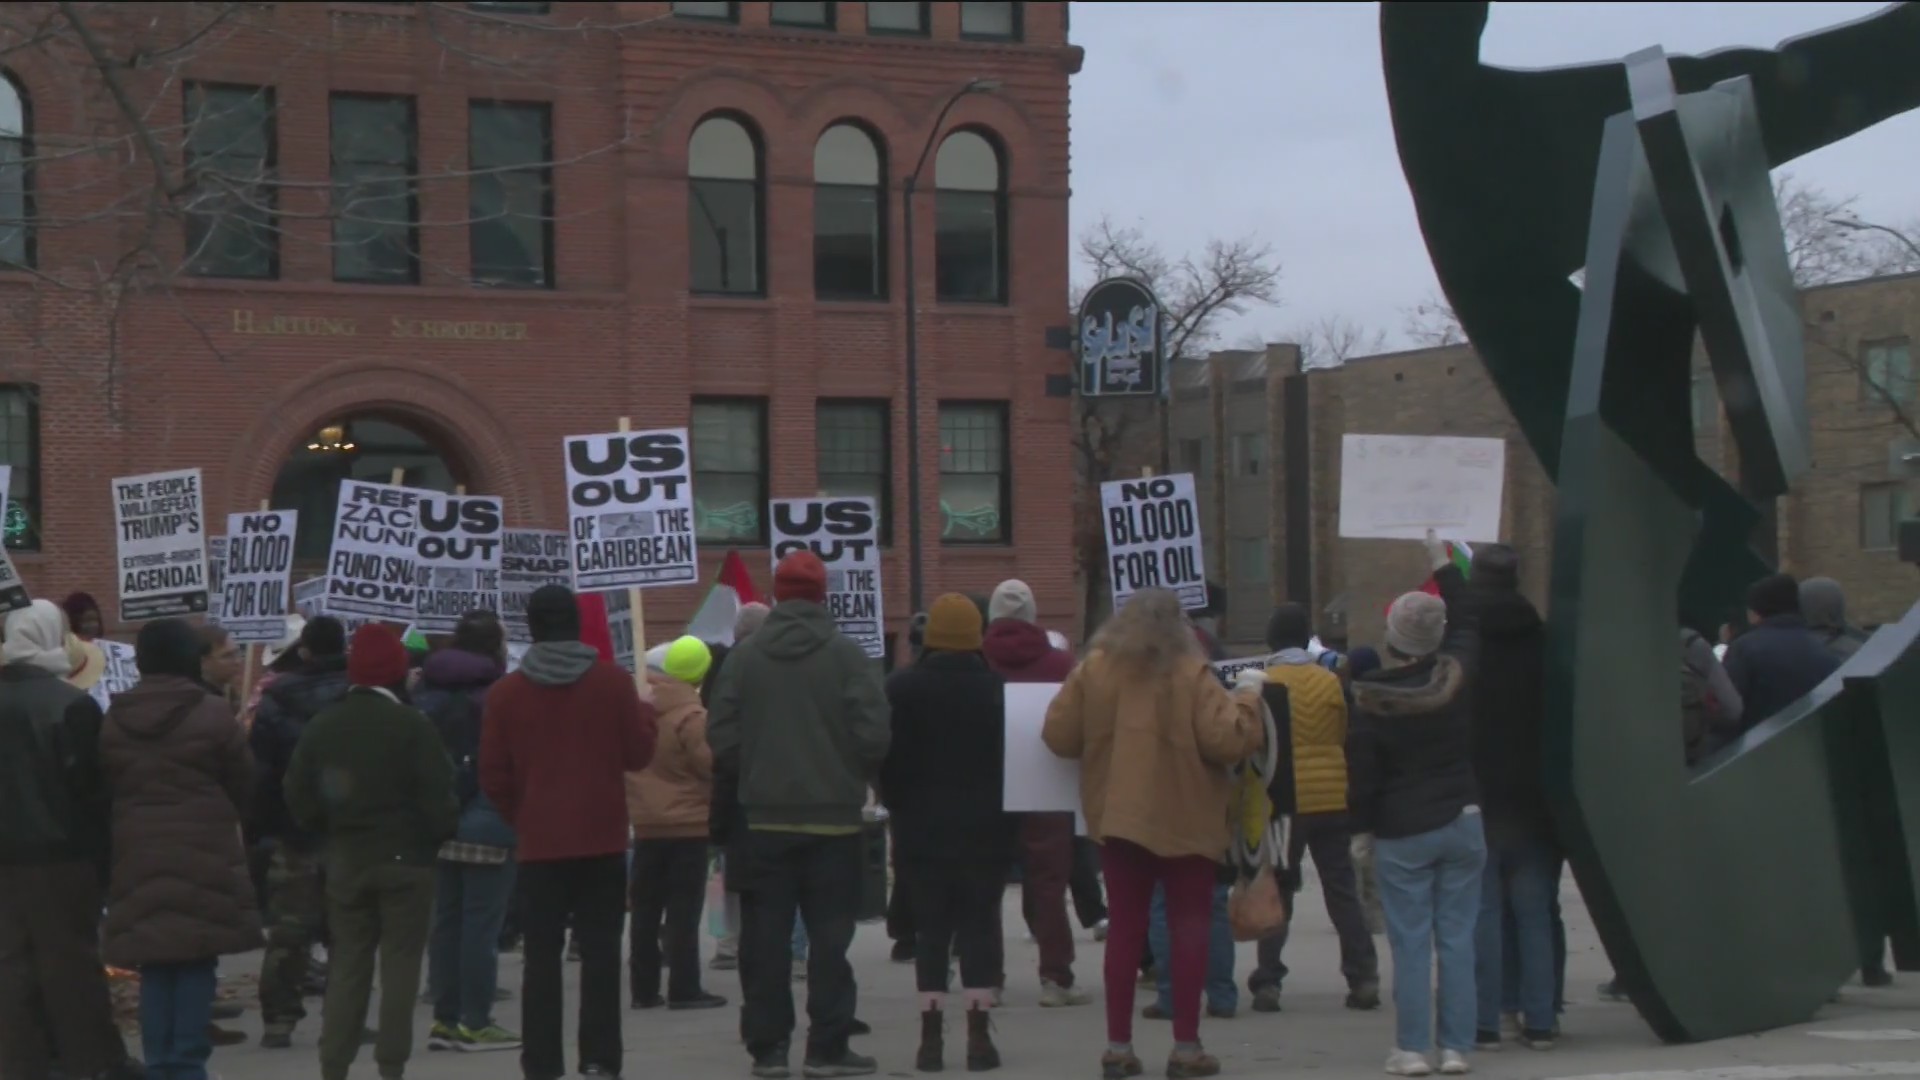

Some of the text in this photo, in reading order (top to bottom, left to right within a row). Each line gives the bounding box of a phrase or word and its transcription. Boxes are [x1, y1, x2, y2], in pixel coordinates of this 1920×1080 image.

[391, 314, 528, 340] SCHROEDER
[568, 433, 685, 476] US
[118, 476, 197, 500] THE PEOPLE
[572, 475, 687, 507] OUT
[1121, 479, 1175, 502] NO
[120, 495, 197, 518] WILL DEFEAT
[341, 503, 418, 529] ZAC
[419, 499, 499, 533] US
[773, 500, 873, 536] US
[121, 512, 199, 542] TRUMP'S
[242, 514, 281, 533] NO
[574, 508, 690, 540] OF THE
[1108, 498, 1194, 546] BLOOD
[229, 535, 290, 575] BLOOD
[417, 537, 499, 560] OUT
[544, 535, 568, 557] OFF
[576, 535, 692, 572] CARIBBEAN
[124, 565, 202, 593] AGENDA!
[332, 551, 380, 580] FUND
[417, 566, 498, 590] OF THE
[501, 557, 570, 574] SNAP
[1112, 545, 1202, 591] FOR OIL
[330, 579, 414, 603] NOW
[847, 569, 875, 591] THE
[223, 581, 255, 617] FOR
[259, 580, 284, 615] OIL
[416, 589, 498, 615] CARIBBEAN
